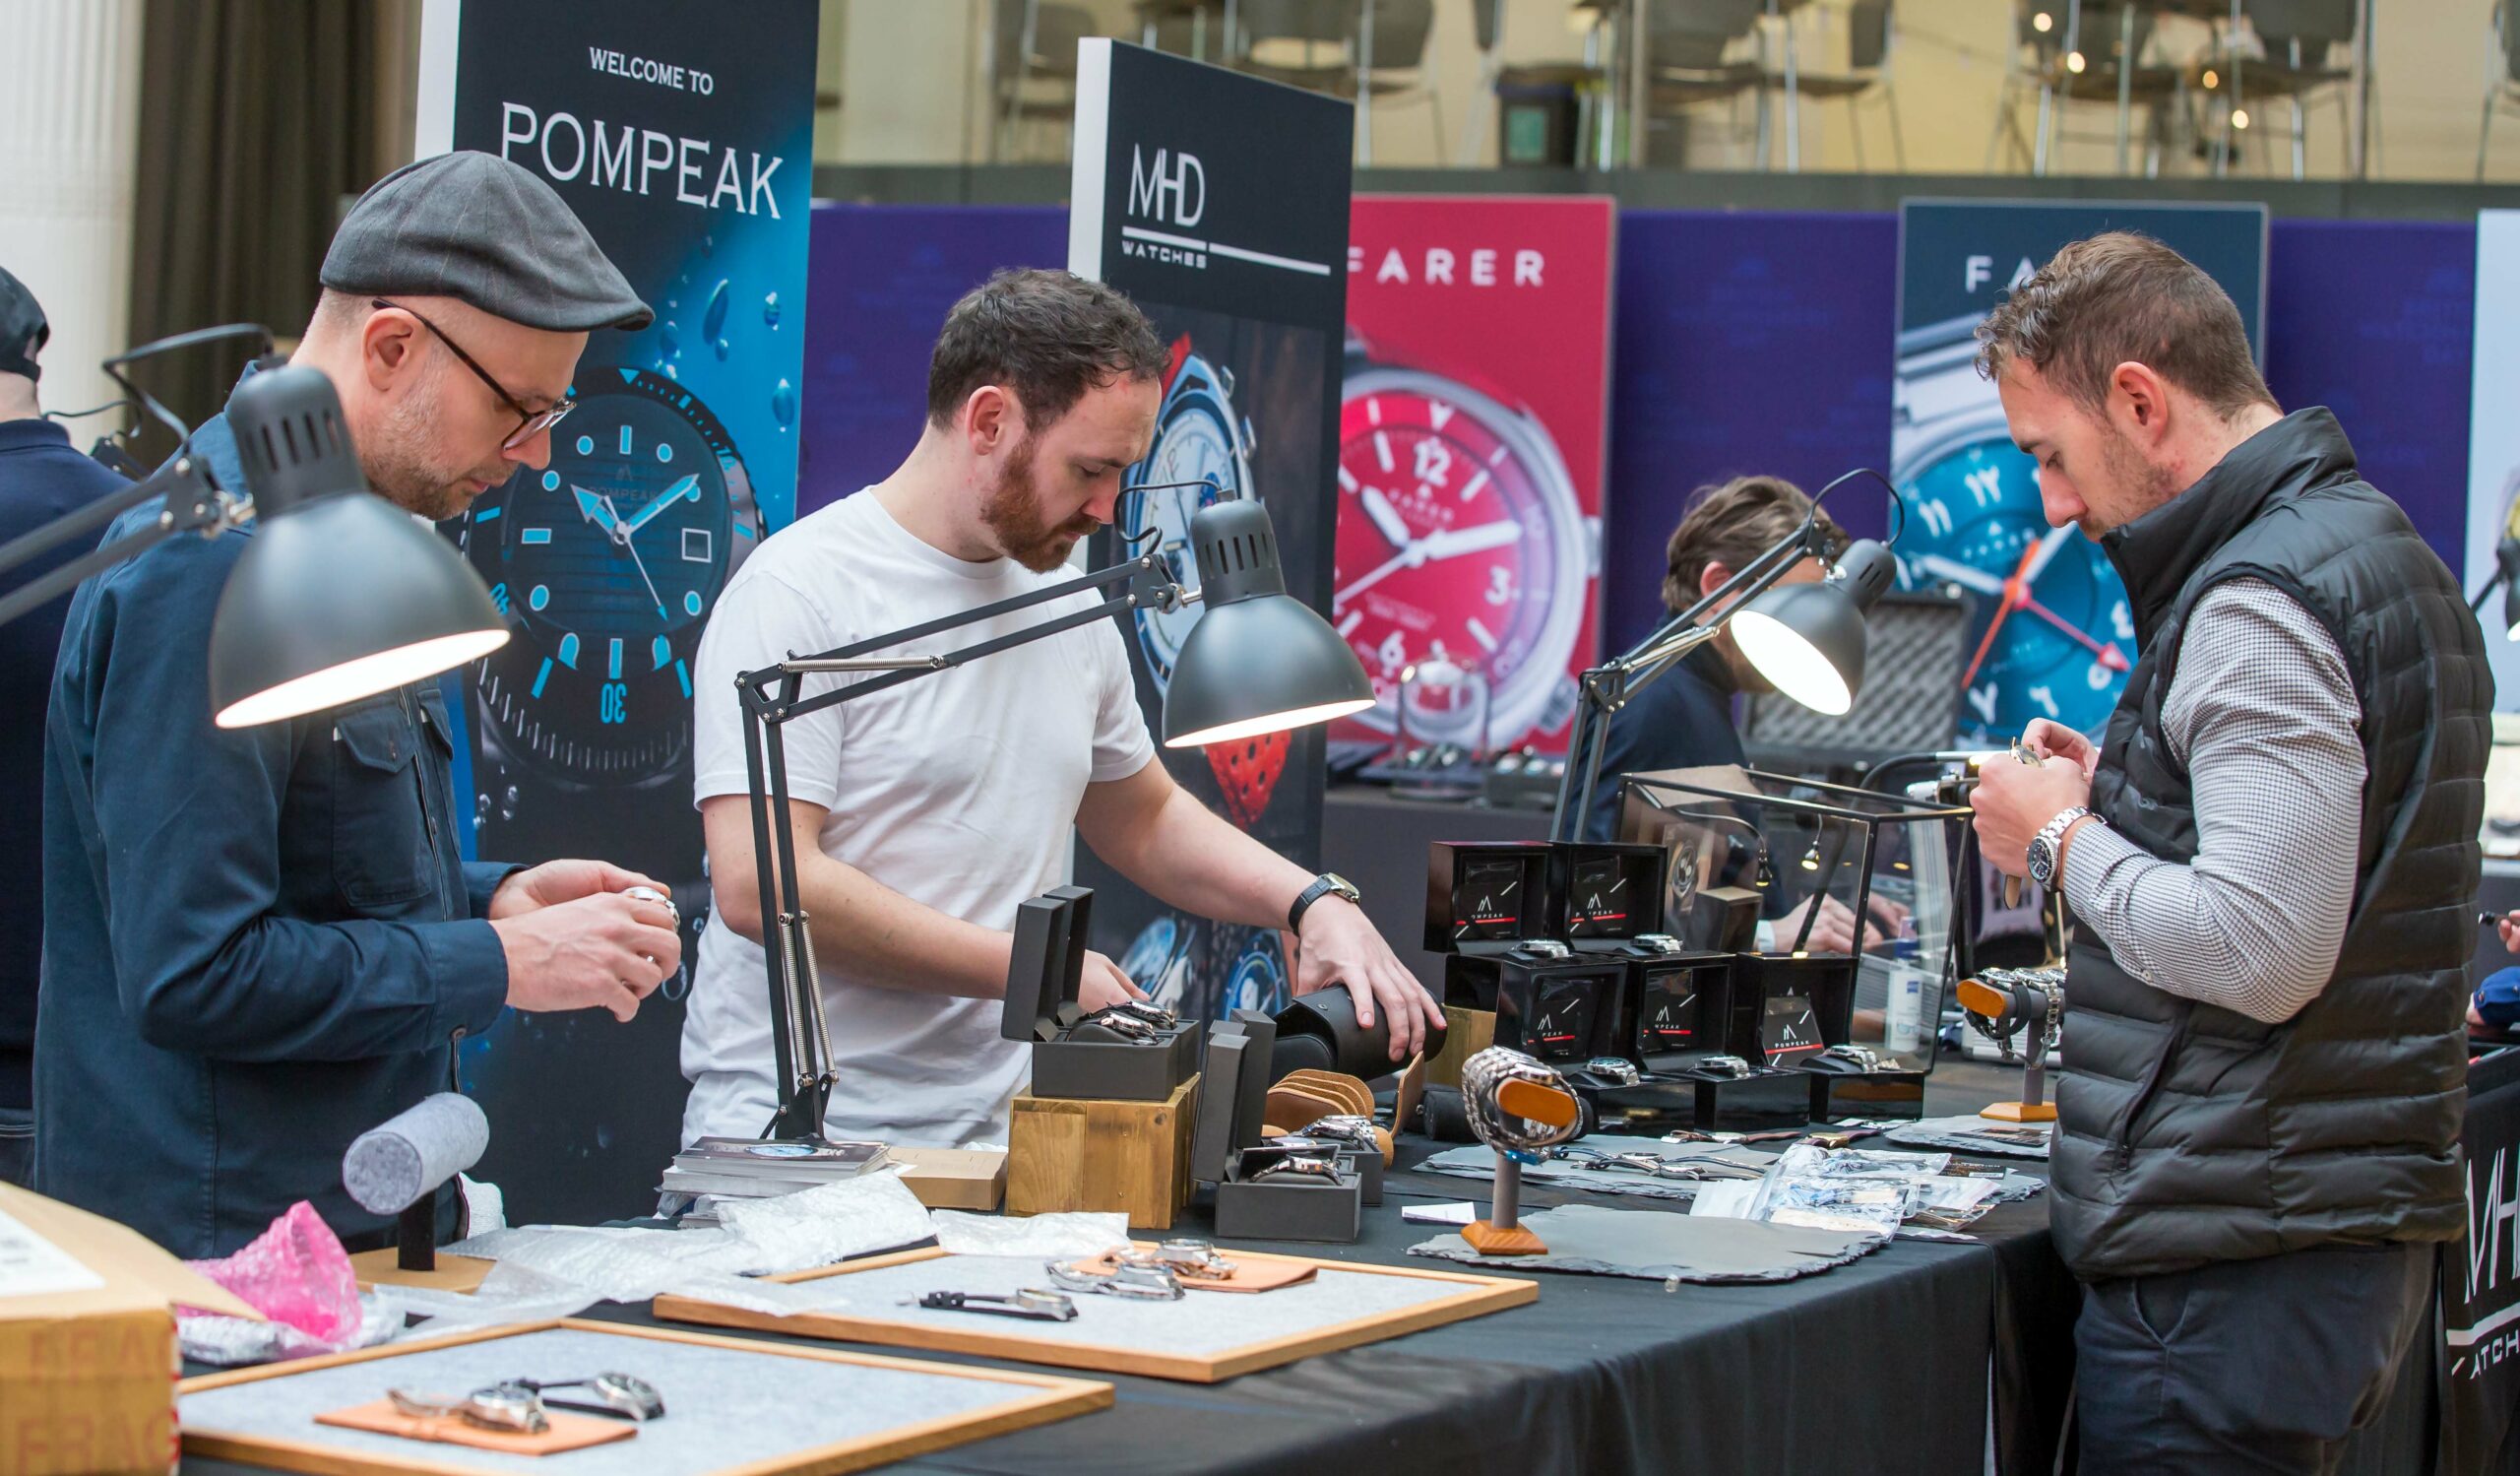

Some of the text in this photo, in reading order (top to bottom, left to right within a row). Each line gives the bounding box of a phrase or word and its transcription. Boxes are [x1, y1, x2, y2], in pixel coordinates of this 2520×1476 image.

[590, 47, 714, 96] WELCOME TO
[502, 101, 784, 220] POMPEAK
[1128, 143, 1205, 226] MHD
[1121, 240, 1207, 269] WATCHES
[1414, 436, 1452, 487] 12
[1484, 566, 1511, 606] 3
[1379, 630, 1406, 667] 6
[600, 683, 627, 724] 30
[2451, 1329, 2520, 1380] ATCH
